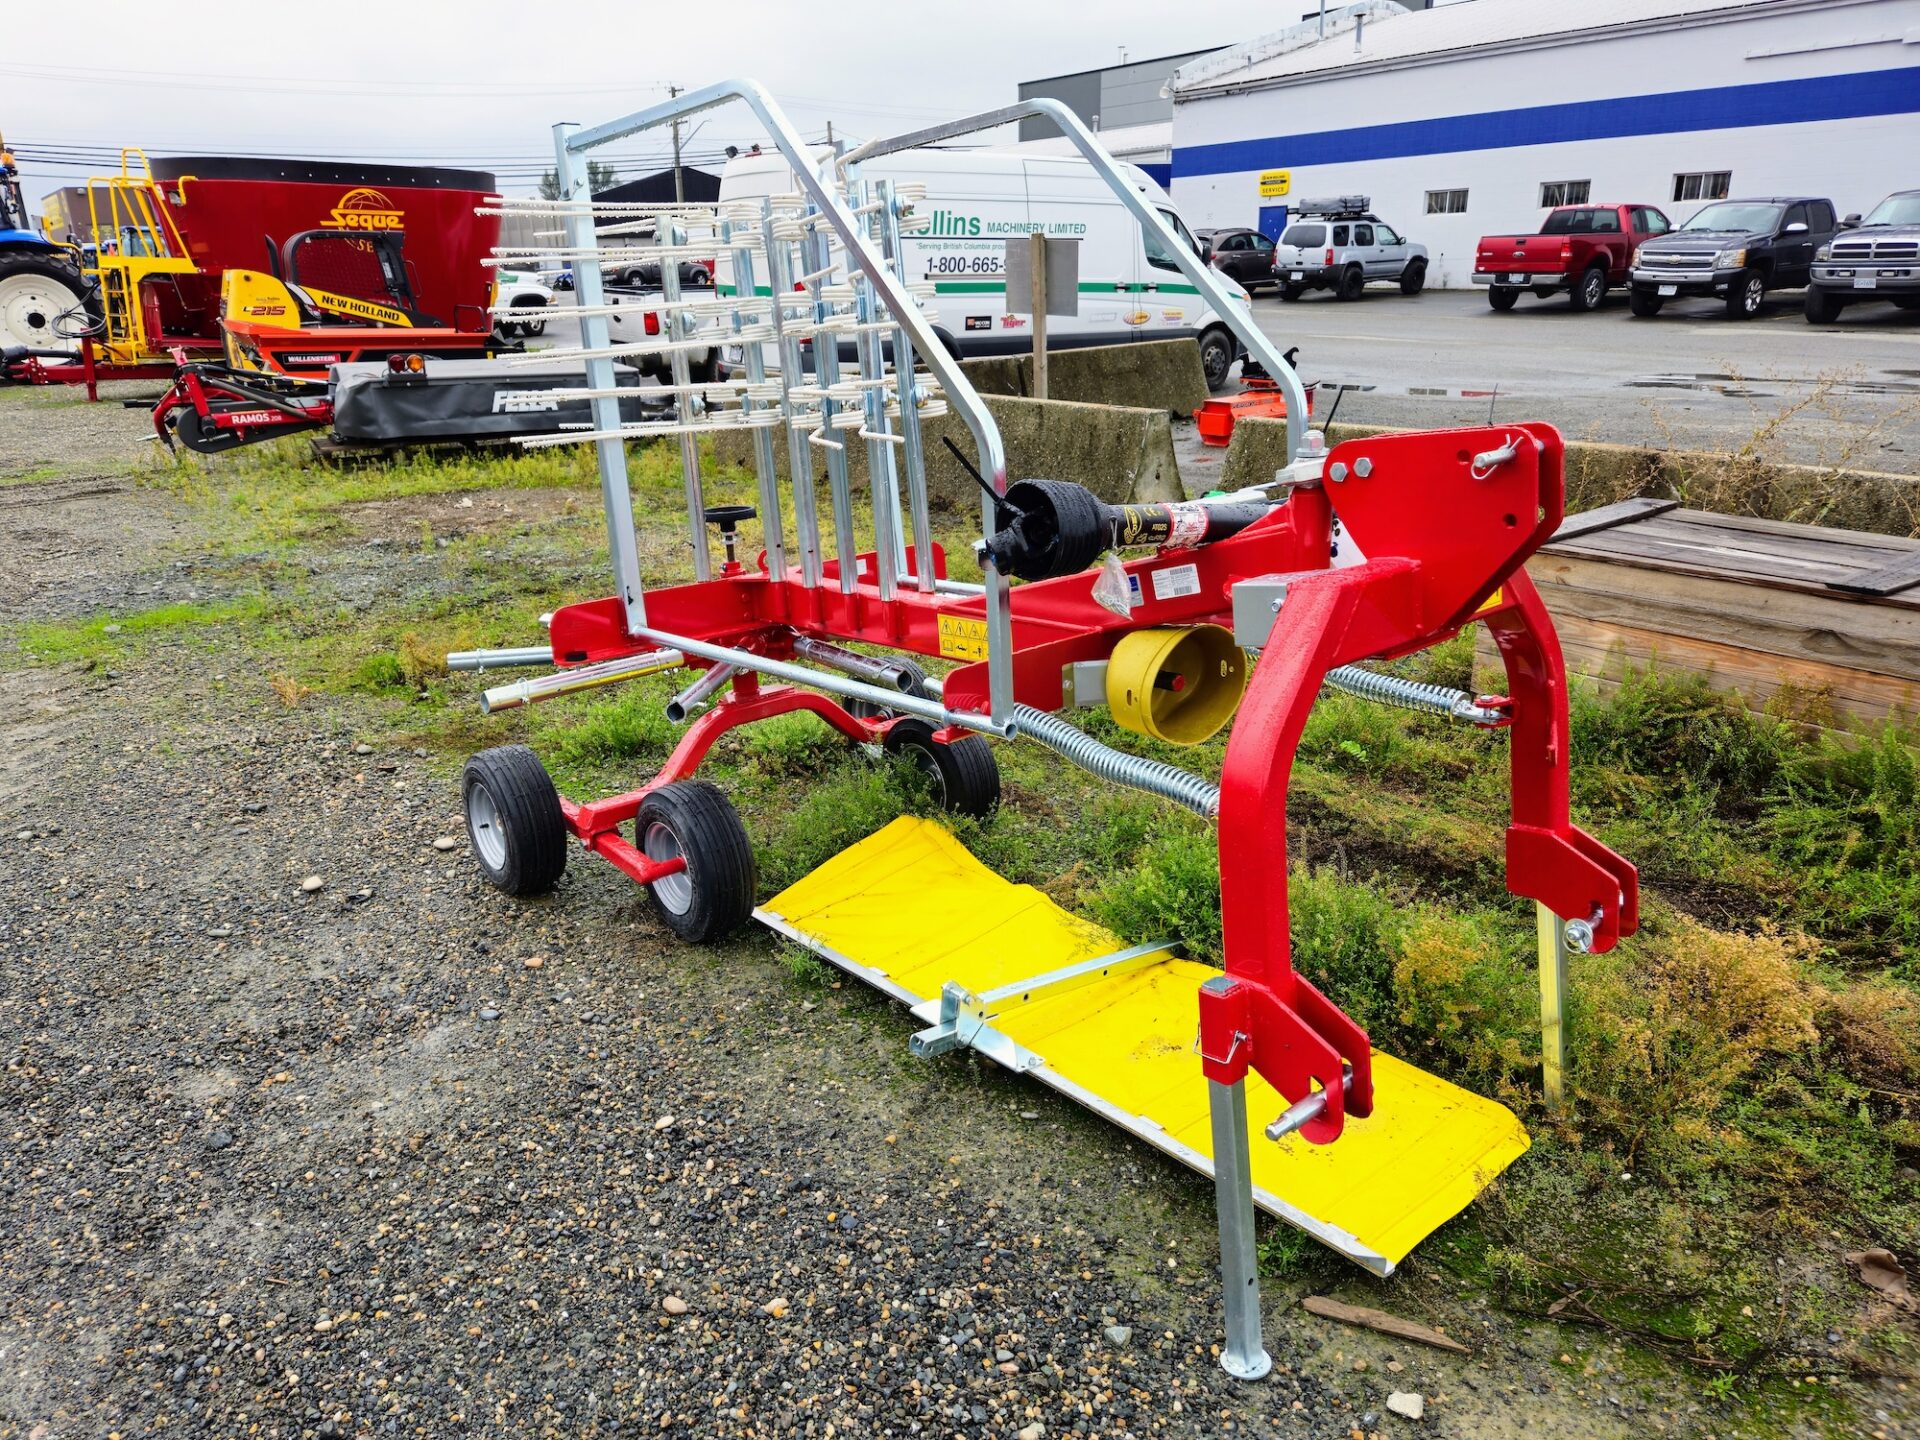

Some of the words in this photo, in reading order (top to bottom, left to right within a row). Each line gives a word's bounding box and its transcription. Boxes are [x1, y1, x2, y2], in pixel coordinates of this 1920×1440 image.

[903, 210, 981, 236] llins
[987, 223, 1045, 235] MACHINERY
[1048, 223, 1087, 234] LIMITED
[926, 256, 1006, 273] 1-800-665-
[321, 295, 348, 309] NEW
[350, 303, 400, 322] HOLLAND
[288, 354, 336, 363] WALLENSTEIN
[231, 413, 270, 425] RAMOS
